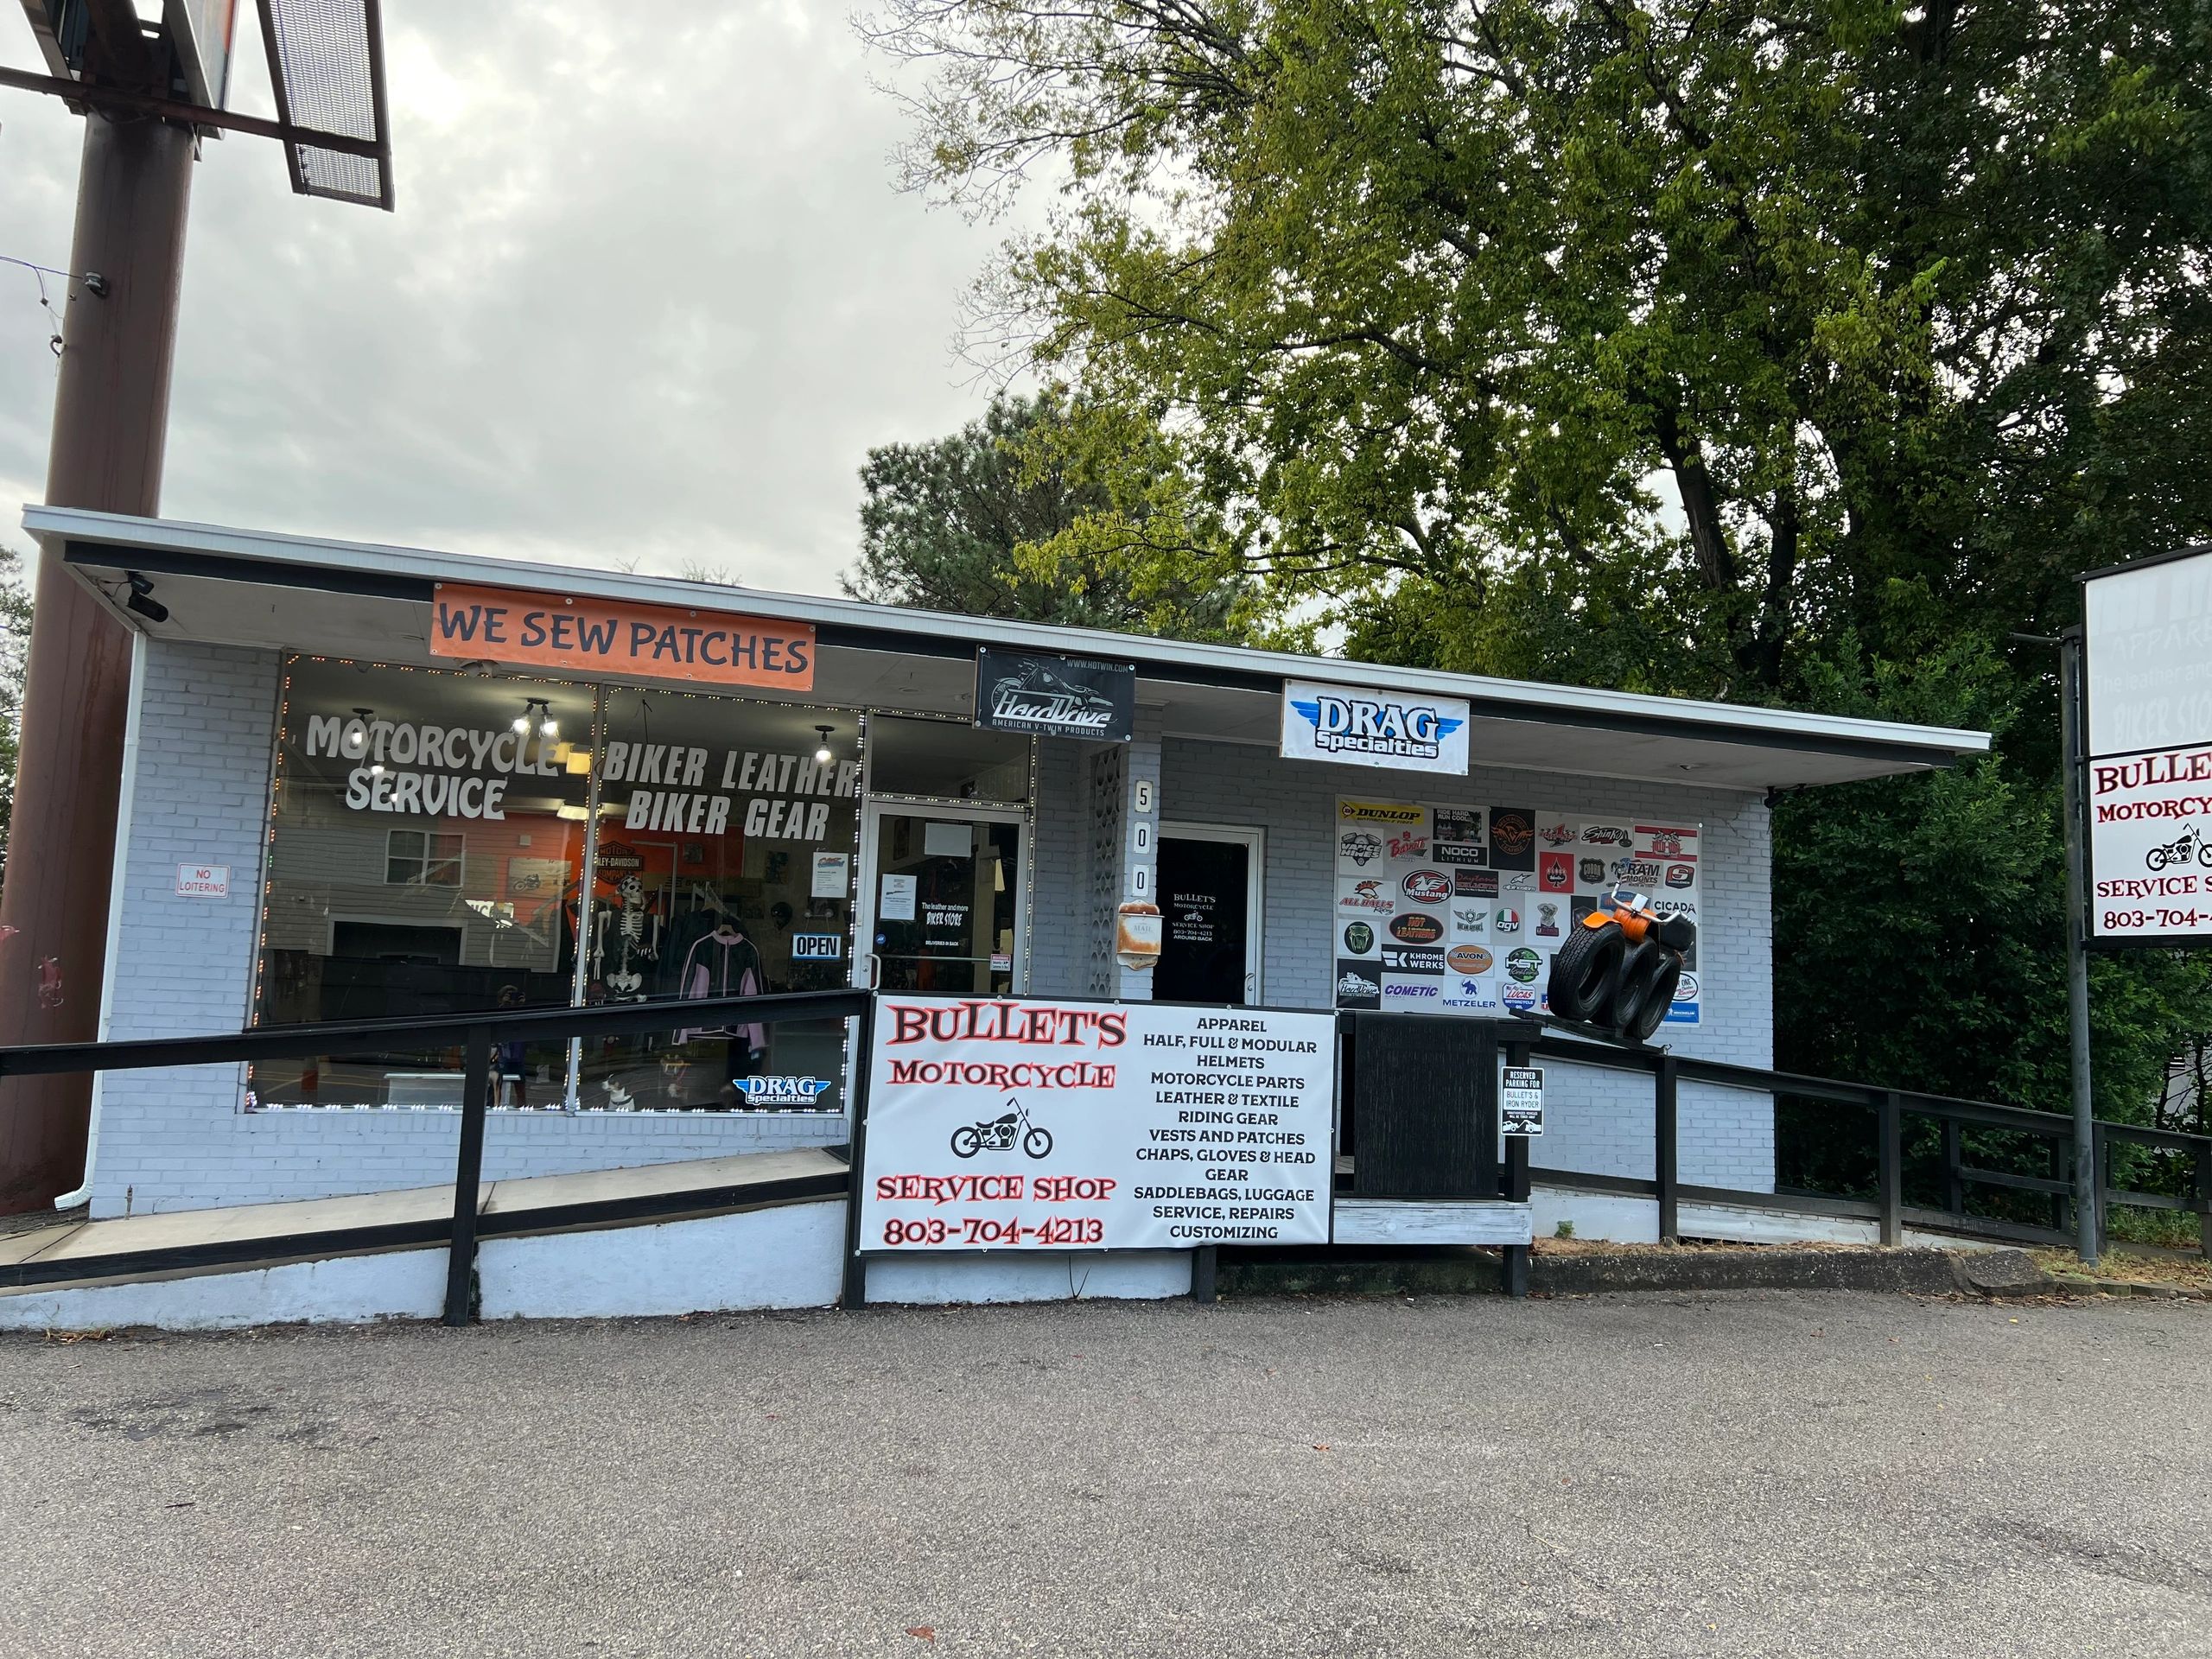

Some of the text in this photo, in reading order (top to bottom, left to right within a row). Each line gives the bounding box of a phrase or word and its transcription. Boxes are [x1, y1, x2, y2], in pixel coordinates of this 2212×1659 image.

[439, 602, 808, 674] WE SEW PATCHES
[993, 689, 1114, 728] HardDrive
[992, 718, 1104, 736] AMERICAN V-TWIN PRODUCTS
[1317, 696, 1439, 743] DRAG
[307, 715, 561, 777] MOTORCYCLE
[1316, 731, 1439, 758] Specialties
[602, 741, 858, 798] BIKER LEATHER
[346, 767, 508, 820] SERVICE
[626, 790, 830, 841] BIKER GEAR
[1357, 808, 1421, 820] DUNLOP
[1441, 846, 1478, 856] NOCO
[196, 869, 211, 879] NO
[1628, 863, 1660, 876] RAM
[180, 881, 225, 893] LOITERING
[1405, 887, 1448, 900] Mustang
[2096, 875, 2197, 899] SERVICE
[1339, 897, 1359, 906] ALL
[1654, 900, 1697, 915] CICADA
[926, 912, 963, 926] BIKER STORE
[1497, 921, 1519, 931] agv
[2103, 907, 2212, 930] 803-704-
[797, 937, 836, 956] OPEN
[1410, 952, 1444, 961] KHROME
[1410, 960, 1444, 969] WERKS
[1385, 984, 1439, 996] COMETIC
[1506, 990, 1533, 999] LUCAS
[1443, 999, 1497, 1008] METZELER
[885, 1001, 1128, 1050] BULLET'S
[1197, 1018, 1268, 1033] APPAREL
[1143, 1034, 1317, 1053] HALF, FULL & MODULAR
[1197, 1055, 1265, 1069] HELMETS
[886, 1059, 1117, 1093] MOTORCYCLE
[1151, 1072, 1305, 1090] MOTORCYCLE PARTS
[1505, 1079, 1529, 1088] PARKING
[748, 1077, 816, 1096] DRAG
[747, 1094, 814, 1103] Specialties
[1155, 1091, 1300, 1108] LEATHER & TEXTILE
[1507, 1090, 1532, 1099] BULLET'S
[1179, 1110, 1279, 1126] RIDING GEAR
[1149, 1129, 1306, 1145] VESTS AND PATCHES
[1136, 1148, 1316, 1164] CHAPS, GLOVES & HEAD
[1205, 1168, 1249, 1181] GEAR
[876, 1174, 1117, 1206] SERVICE SHOP
[1134, 1186, 1314, 1201] SADDLEBAGS, LUGGAGE
[1153, 1206, 1294, 1220] SERVICE, REPAIRS
[883, 1216, 1104, 1246] 803-704-4213
[1170, 1225, 1279, 1239] CUSTOMIZING
